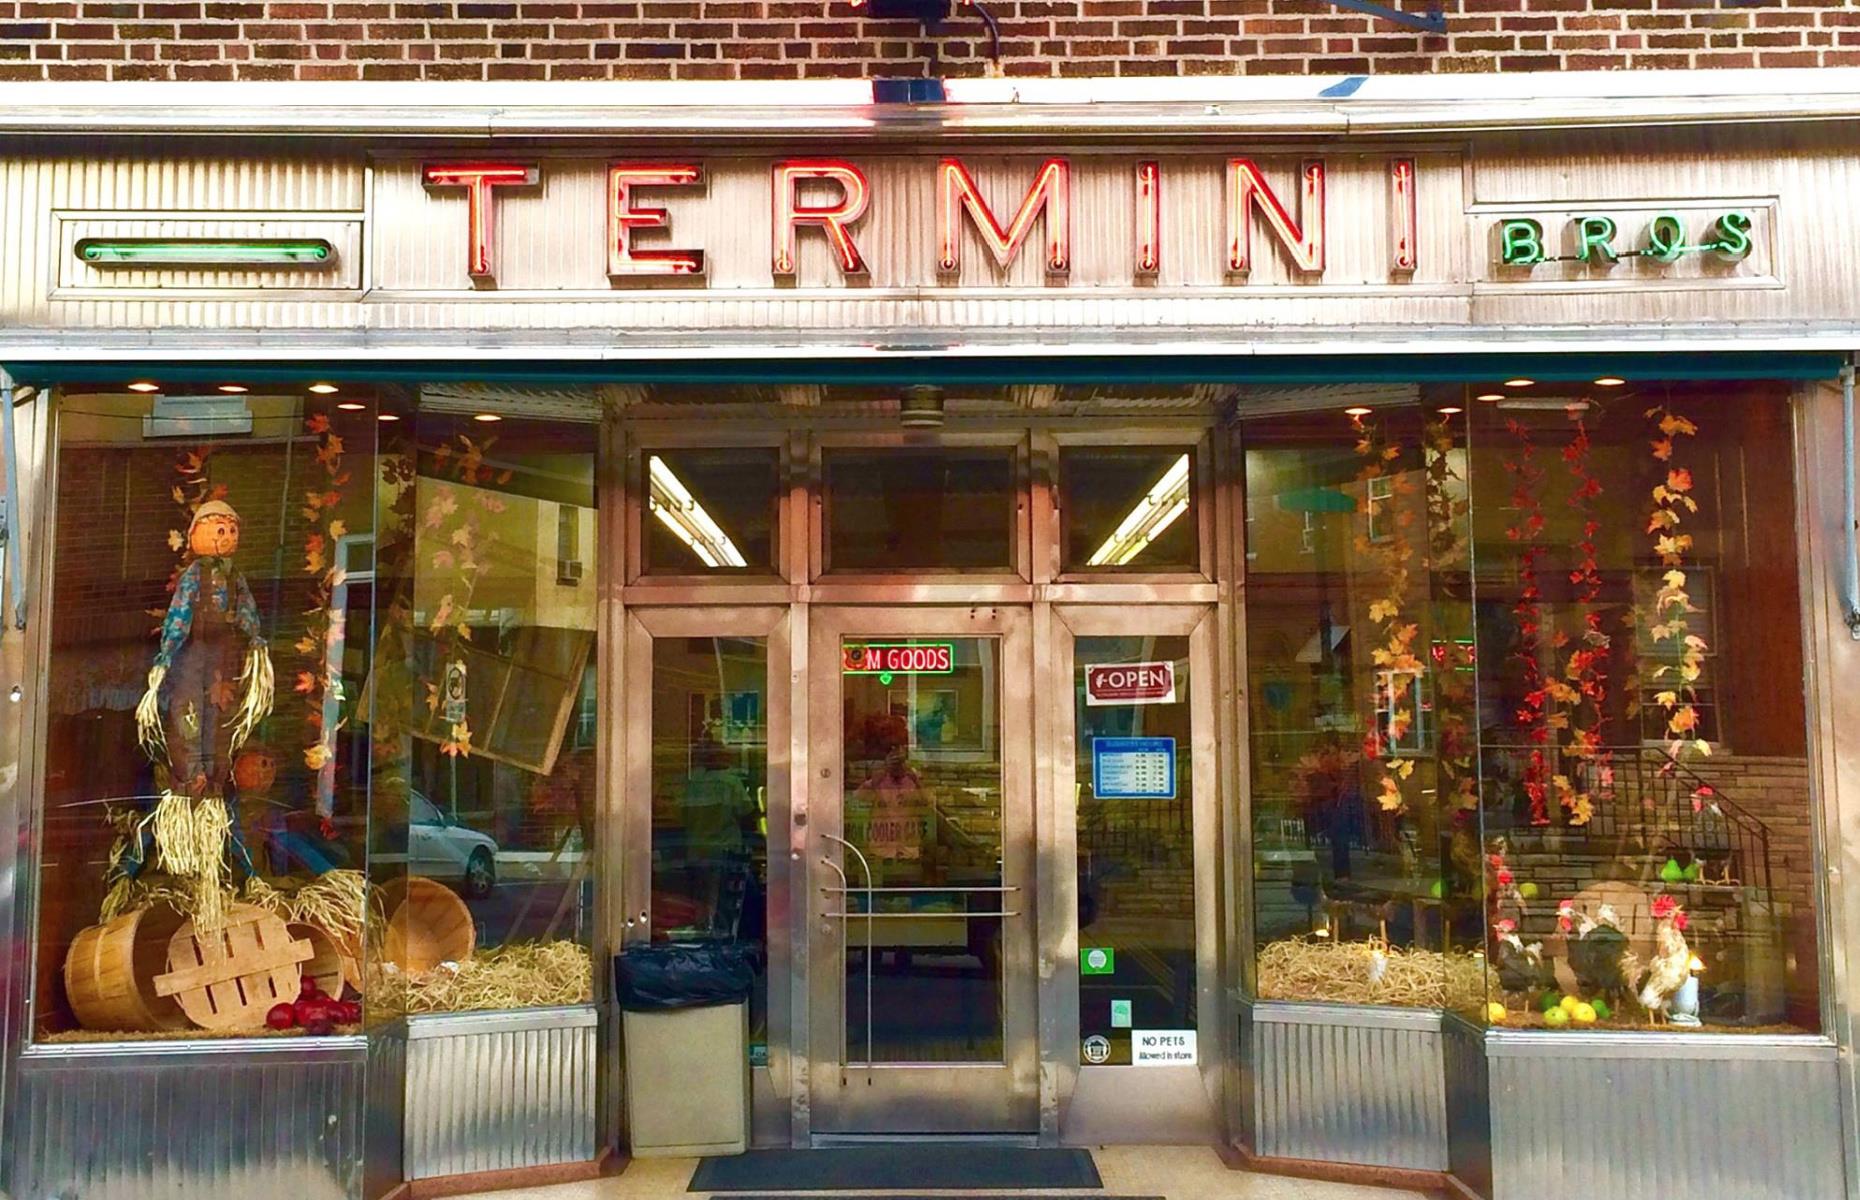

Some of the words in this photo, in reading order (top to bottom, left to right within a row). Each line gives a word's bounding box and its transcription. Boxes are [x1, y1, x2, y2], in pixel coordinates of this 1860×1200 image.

[422, 158, 1418, 287] TERMINI
[1500, 210, 1752, 265] BROS
[887, 649, 949, 670] GOODS
[1108, 670, 1164, 688] OPEN
[1142, 1036, 1157, 1046] NO
[1160, 1036, 1185, 1046] PETS
